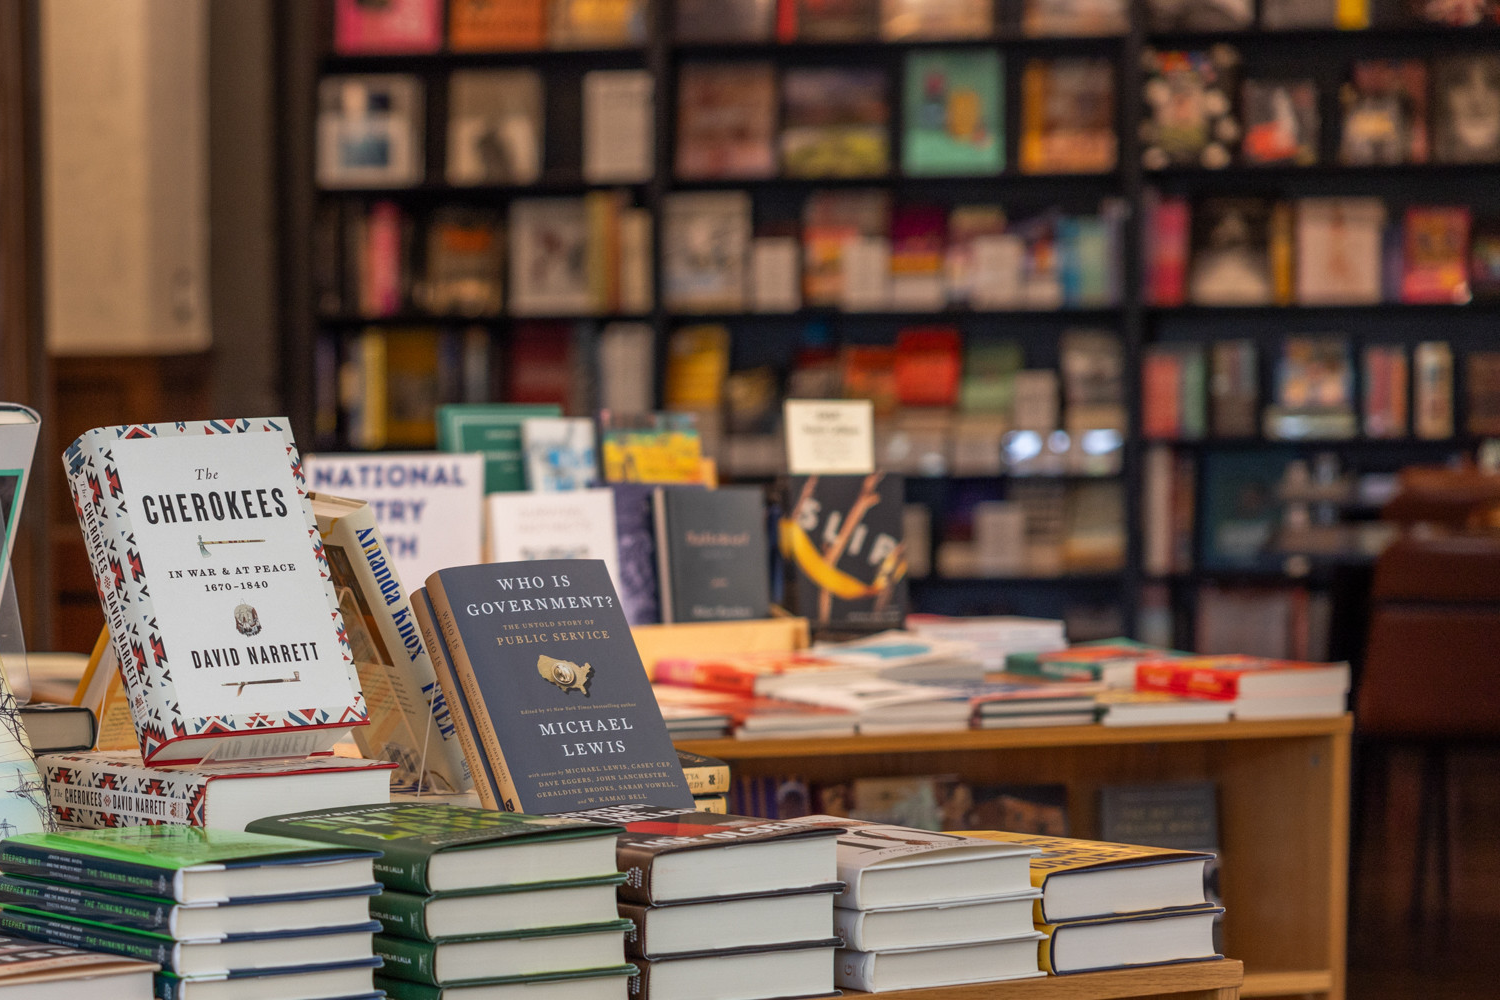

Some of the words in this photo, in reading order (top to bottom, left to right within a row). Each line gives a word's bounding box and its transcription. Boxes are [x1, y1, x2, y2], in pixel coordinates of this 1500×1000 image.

[195, 468, 219, 480] The
[313, 463, 464, 488] NATIONAL
[142, 488, 287, 524] CHEROKEES
[168, 570, 182, 579] IN
[188, 568, 217, 577] WAR
[222, 567, 230, 575] &
[235, 566, 250, 575] AT
[255, 563, 296, 573] PEACE
[356, 526, 402, 606] Amanda
[497, 576, 544, 591] WHO
[552, 575, 570, 588] IS
[467, 596, 613, 617] GOVERNMENT?
[496, 634, 548, 646] PUBLIC
[553, 630, 610, 641] SERVICE
[191, 648, 240, 668] DAVID
[247, 642, 318, 665] NARRETT
[539, 718, 633, 736] MICHAEL
[562, 740, 626, 756] LEWIS
[2, 853, 26, 863] STEPHEN
[87, 868, 98, 876] THE
[100, 870, 126, 882] THINKING
[128, 876, 153, 887] MACHINE
